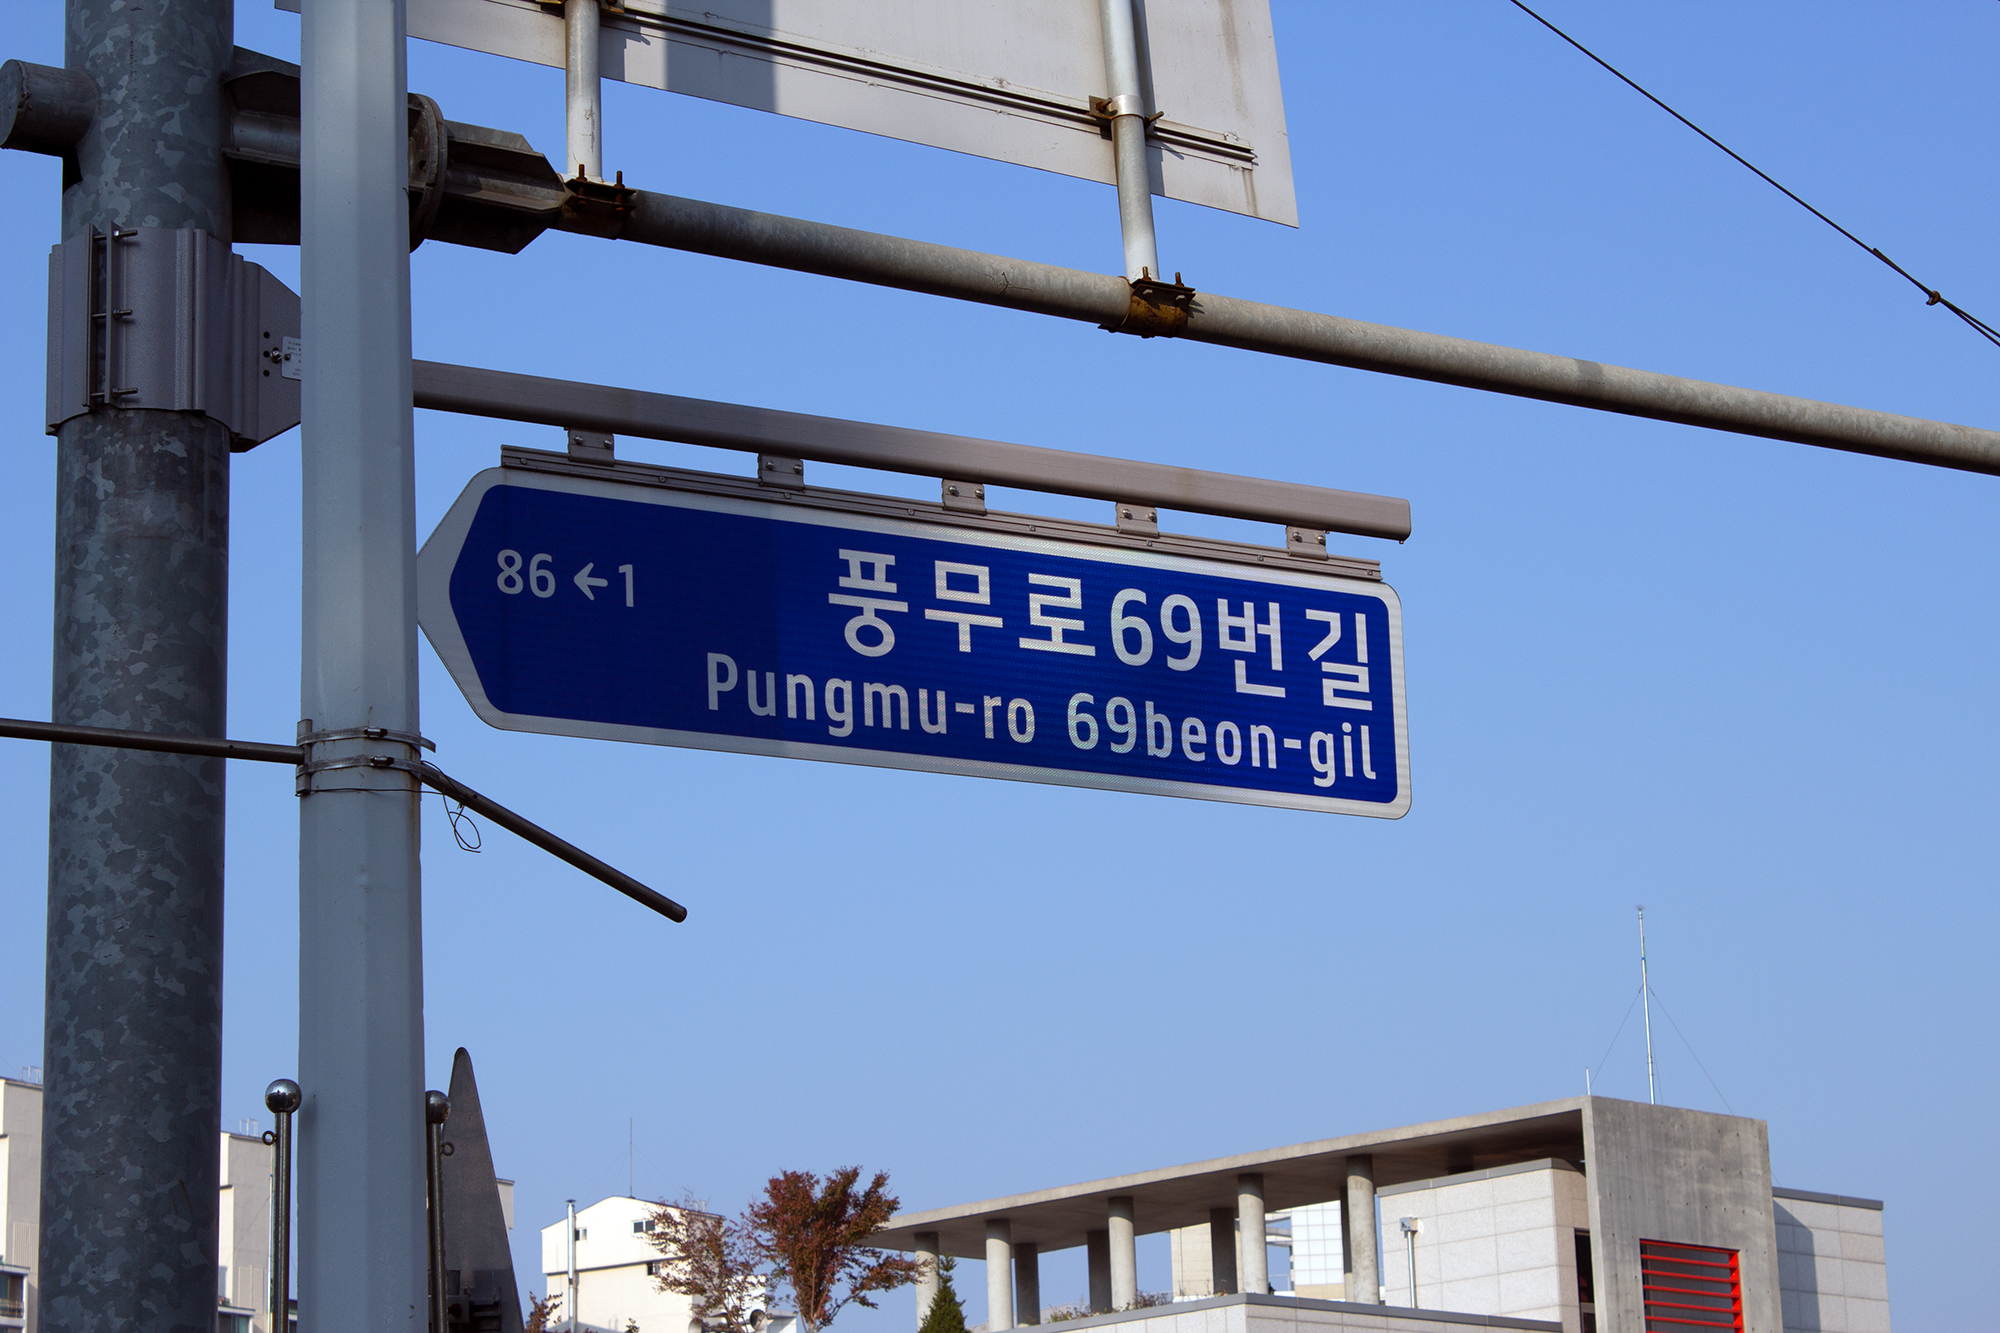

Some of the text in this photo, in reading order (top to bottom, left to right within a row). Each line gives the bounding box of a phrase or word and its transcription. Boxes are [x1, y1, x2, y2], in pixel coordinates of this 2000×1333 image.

[496, 548, 634, 607] 86 1
[828, 548, 1373, 711] 풍무로69번길
[706, 652, 1377, 788] Pungmu-ro 69beon-gil
